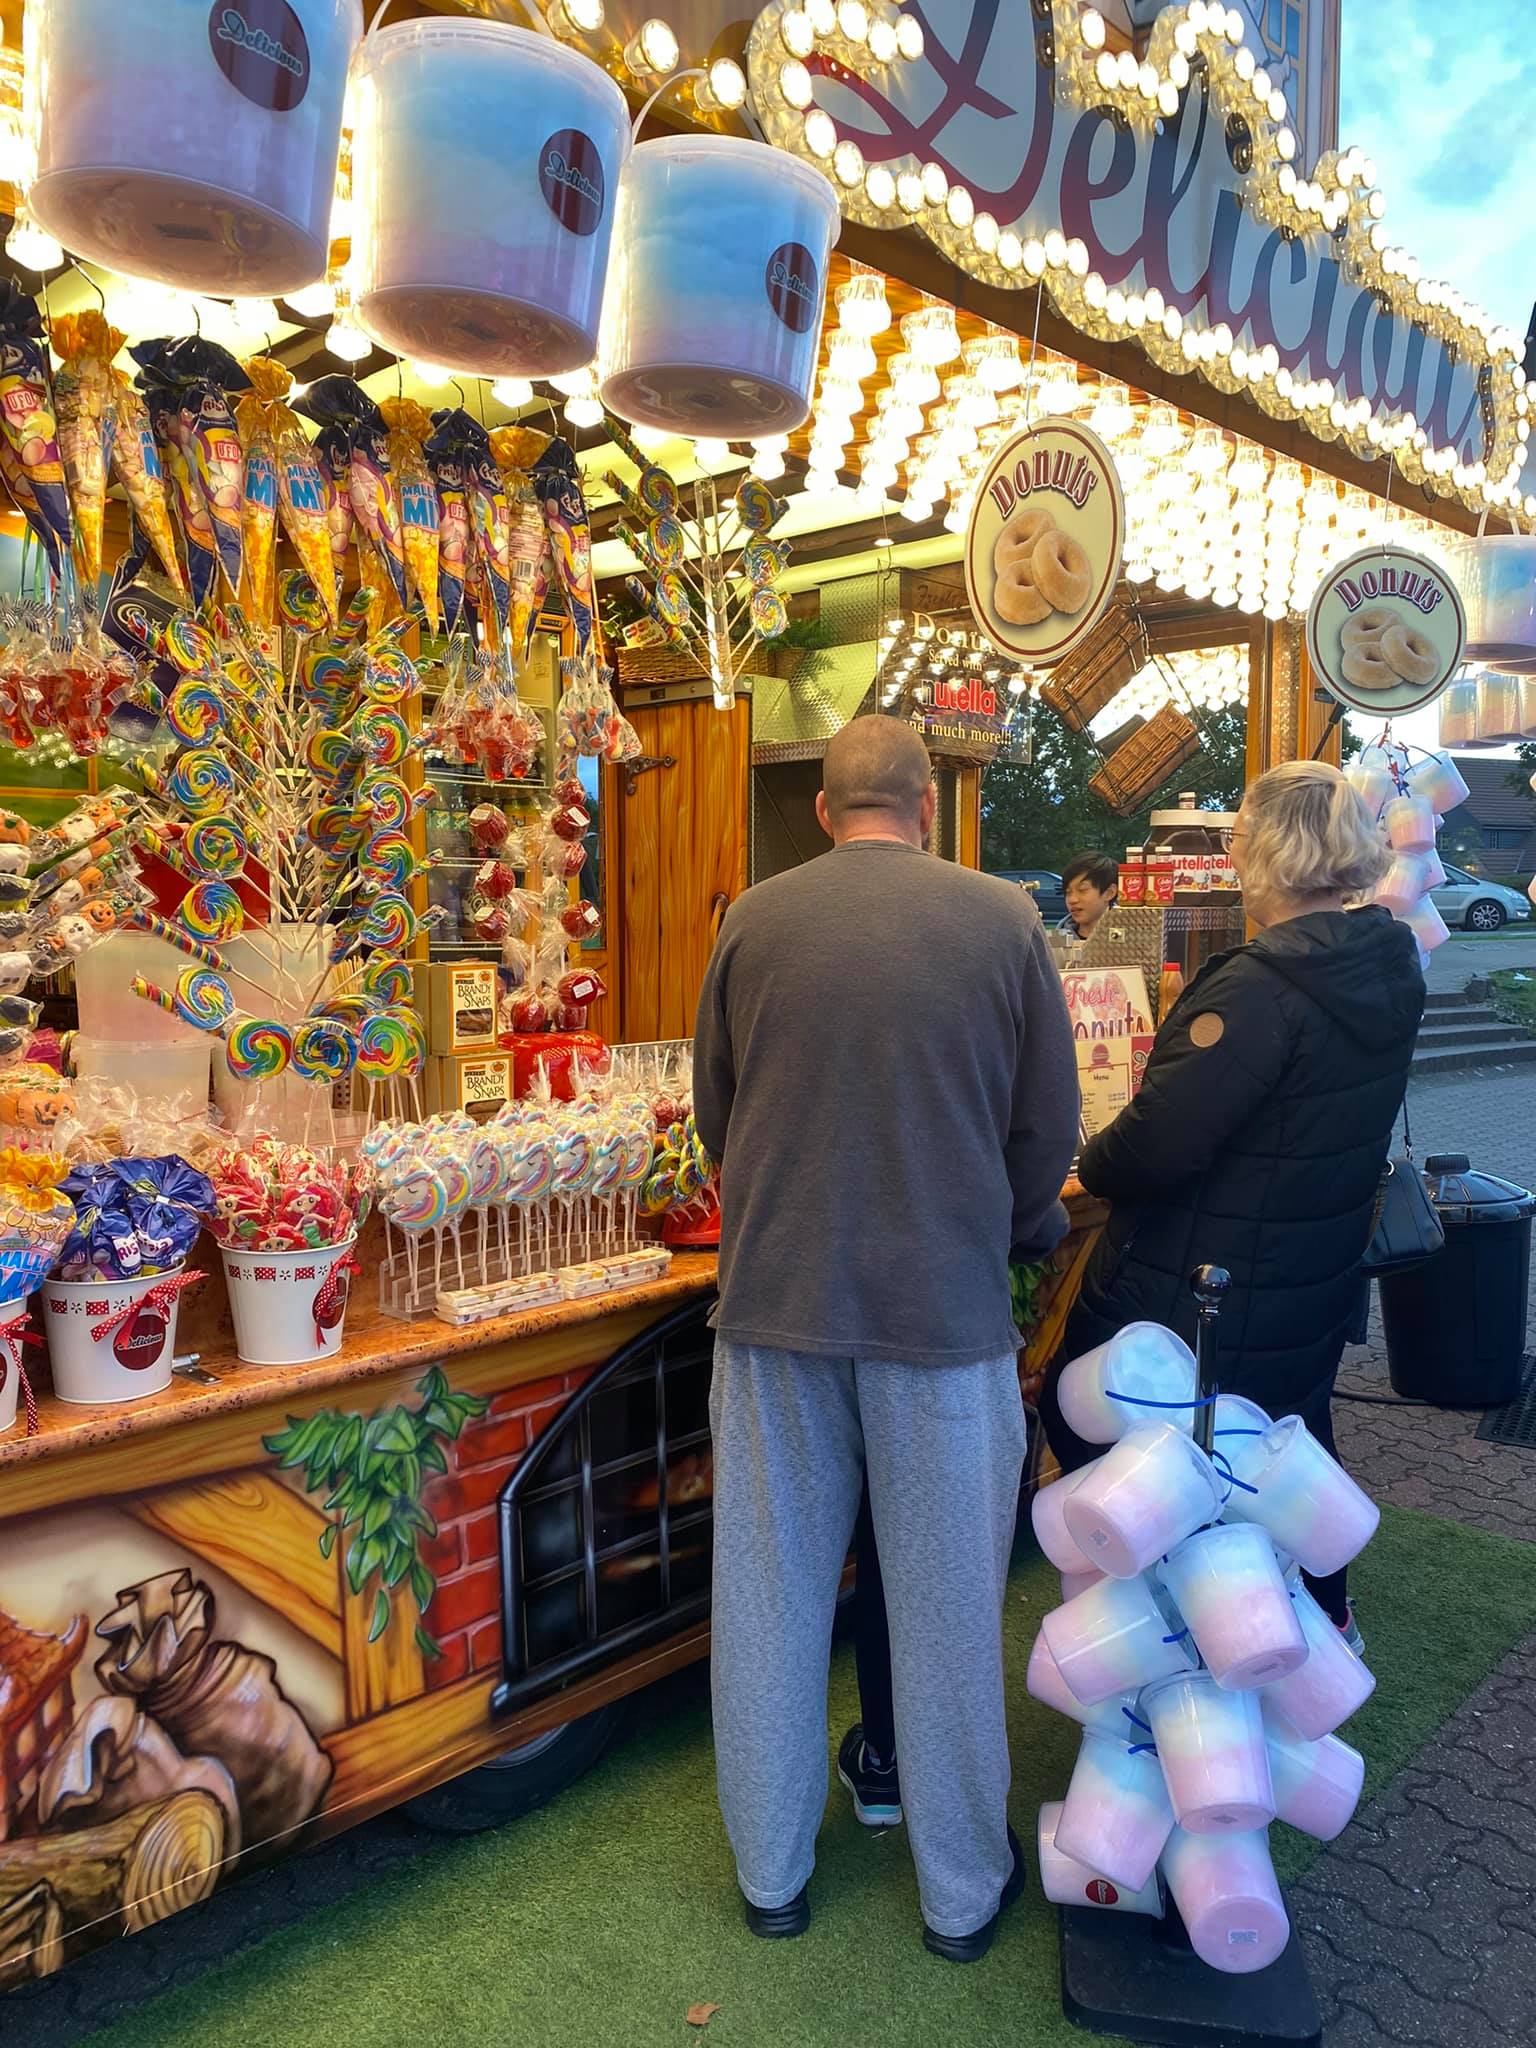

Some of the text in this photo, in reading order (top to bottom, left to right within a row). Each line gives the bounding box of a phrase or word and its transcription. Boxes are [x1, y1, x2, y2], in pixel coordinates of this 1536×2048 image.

[217, 9, 303, 76] Delicious
[800, 0, 1484, 468] Deliciou
[989, 448, 1098, 519] Donuts
[1334, 567, 1444, 613] Donuts
[928, 648, 983, 672] Served with
[921, 678, 996, 716] nutella
[931, 718, 966, 739] much
[1173, 856, 1211, 870] utella
[1211, 856, 1232, 869] tell
[457, 982, 491, 998] BRANDY
[464, 995, 491, 1008] SNAPS
[1062, 974, 1117, 1009] Fresh
[1074, 1001, 1145, 1039] onuts
[467, 1074, 505, 1089] BRANDY
[473, 1086, 505, 1100] SNAPS
